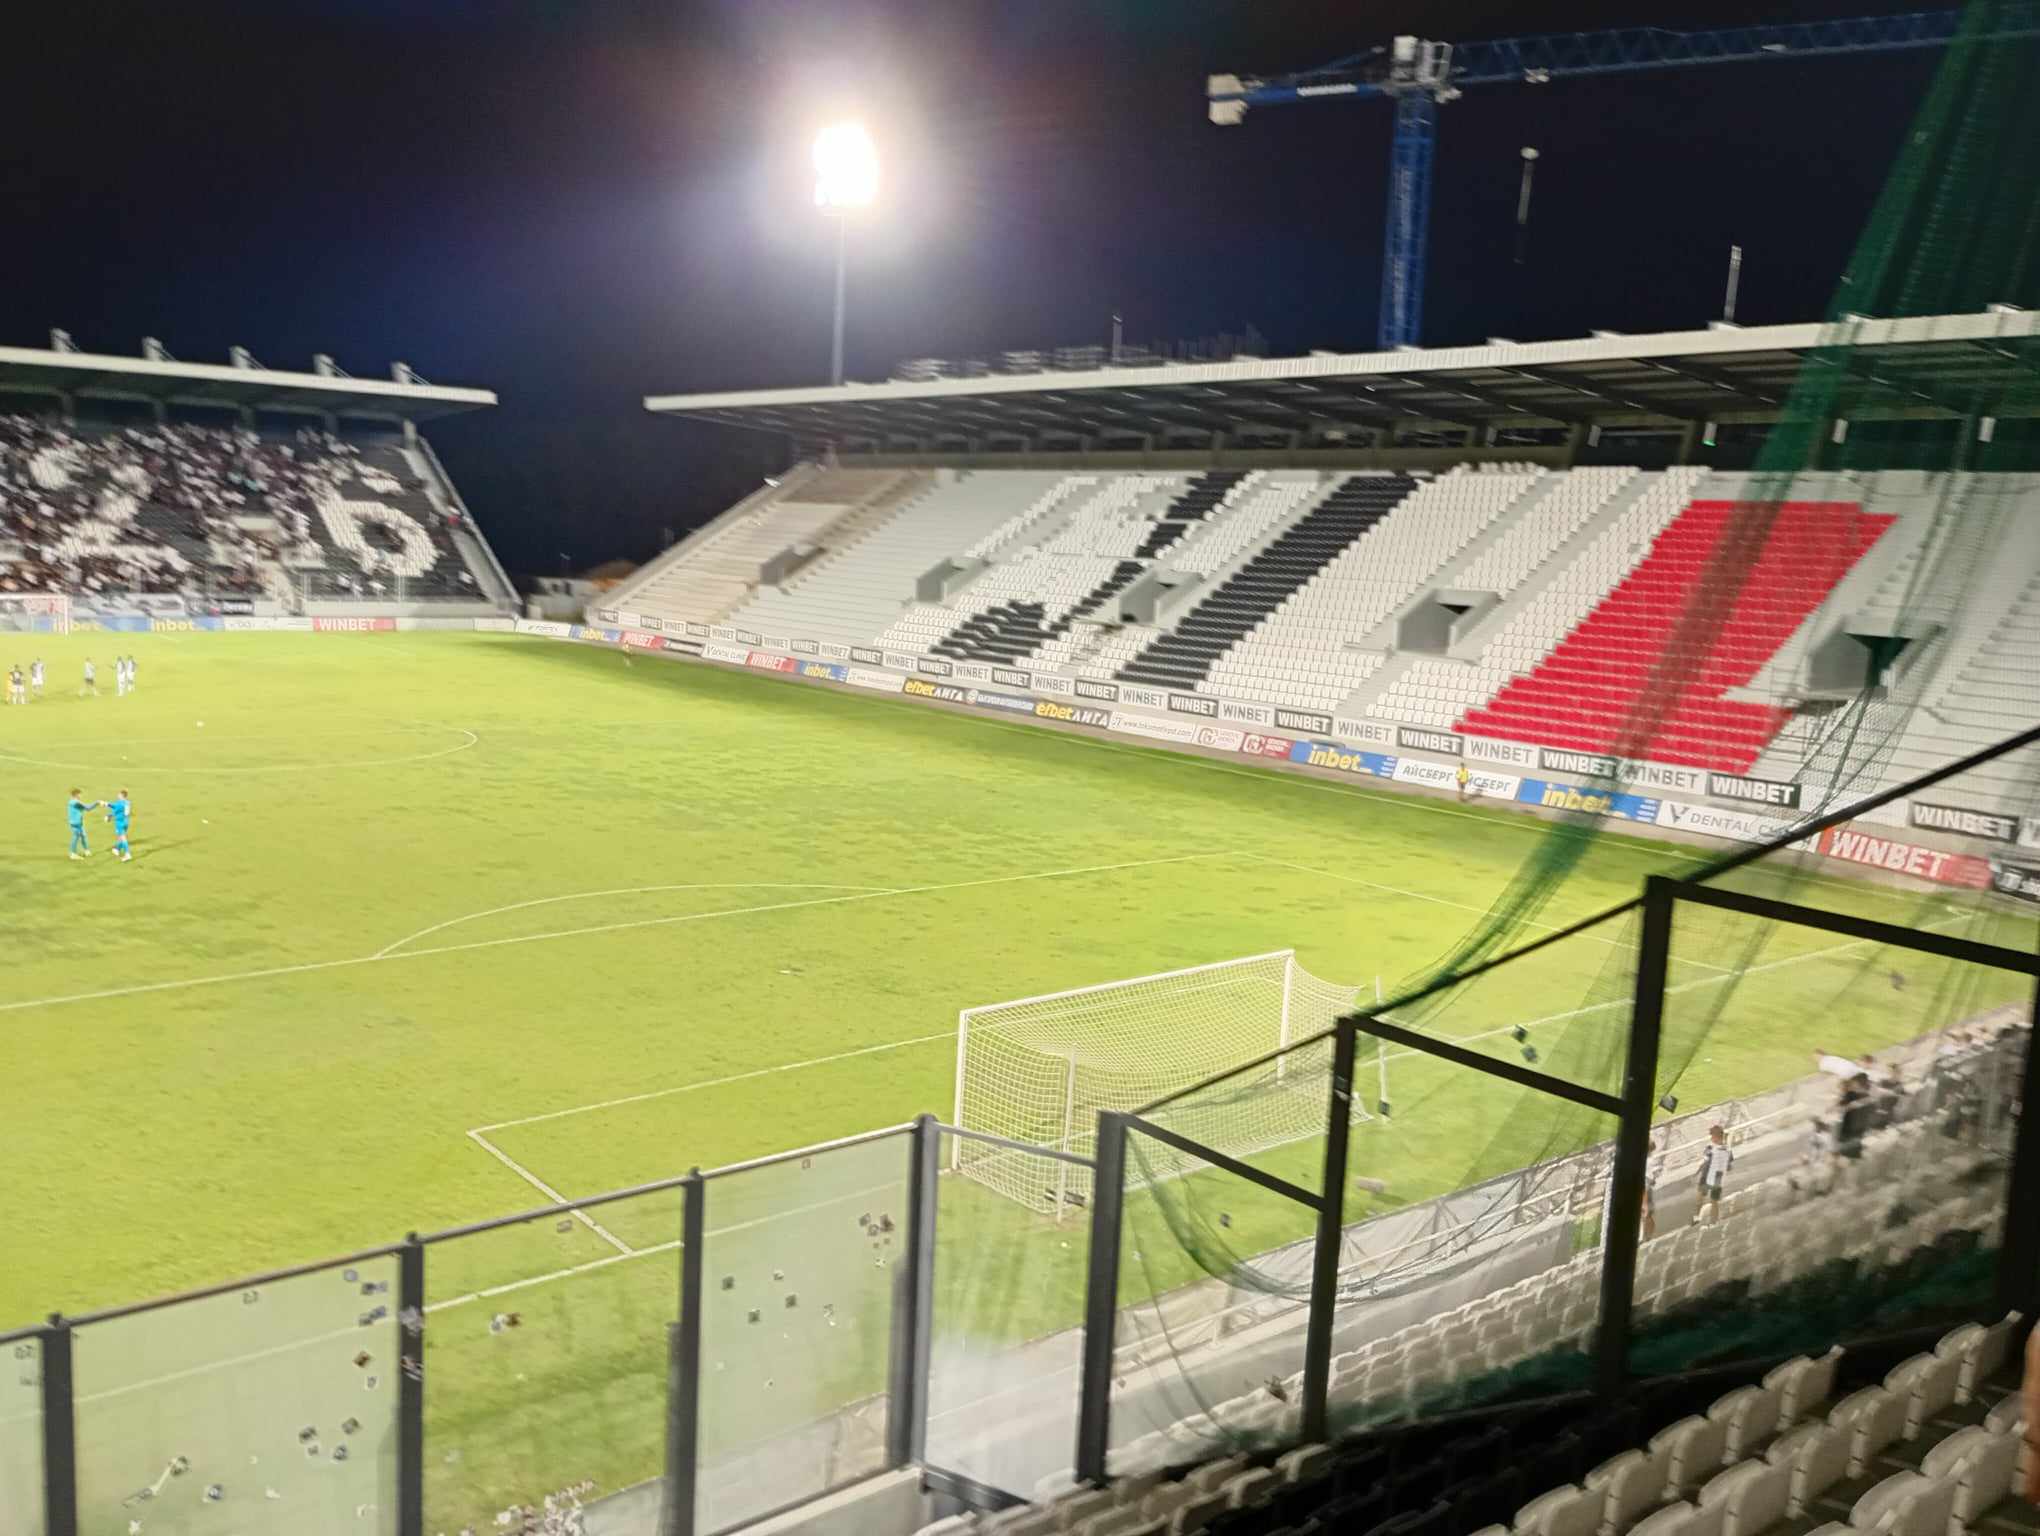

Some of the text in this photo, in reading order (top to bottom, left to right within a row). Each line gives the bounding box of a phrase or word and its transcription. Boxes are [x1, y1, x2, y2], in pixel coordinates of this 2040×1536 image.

[320, 618, 375, 630] WINBET
[792, 640, 817, 656] WINBET
[853, 648, 881, 665] WINBET
[751, 652, 785, 671] WINBET
[886, 653, 916, 671] WINBET
[920, 661, 951, 676] WINBET
[955, 665, 988, 682] WINBET
[994, 670, 1030, 687] WINBET
[1033, 677, 1071, 695] WINBET
[1077, 682, 1117, 700] WINBET
[1122, 689, 1164, 708] WINBET
[1170, 695, 1217, 716] WINBET
[1035, 701, 1074, 719] efbet
[1223, 703, 1271, 724] WINBET
[1279, 711, 1330, 734] WINBET
[1338, 720, 1393, 742] WINBET
[1401, 729, 1462, 756] WINBET
[1470, 740, 1534, 763] WINBET
[1308, 744, 1361, 771] inbet
[1542, 751, 1616, 778] WINBET
[1402, 764, 1455, 781] АЙСБЕРГ
[1624, 764, 1699, 789] WINBET
[1466, 773, 1512, 793] ЙСБЕРГ
[1711, 774, 1795, 805] WINBET
[1541, 783, 1612, 814] inbet
[1690, 812, 1754, 835] DENTAL
[1913, 805, 2018, 840] WINBET
[1828, 828, 1951, 878] WINBET
